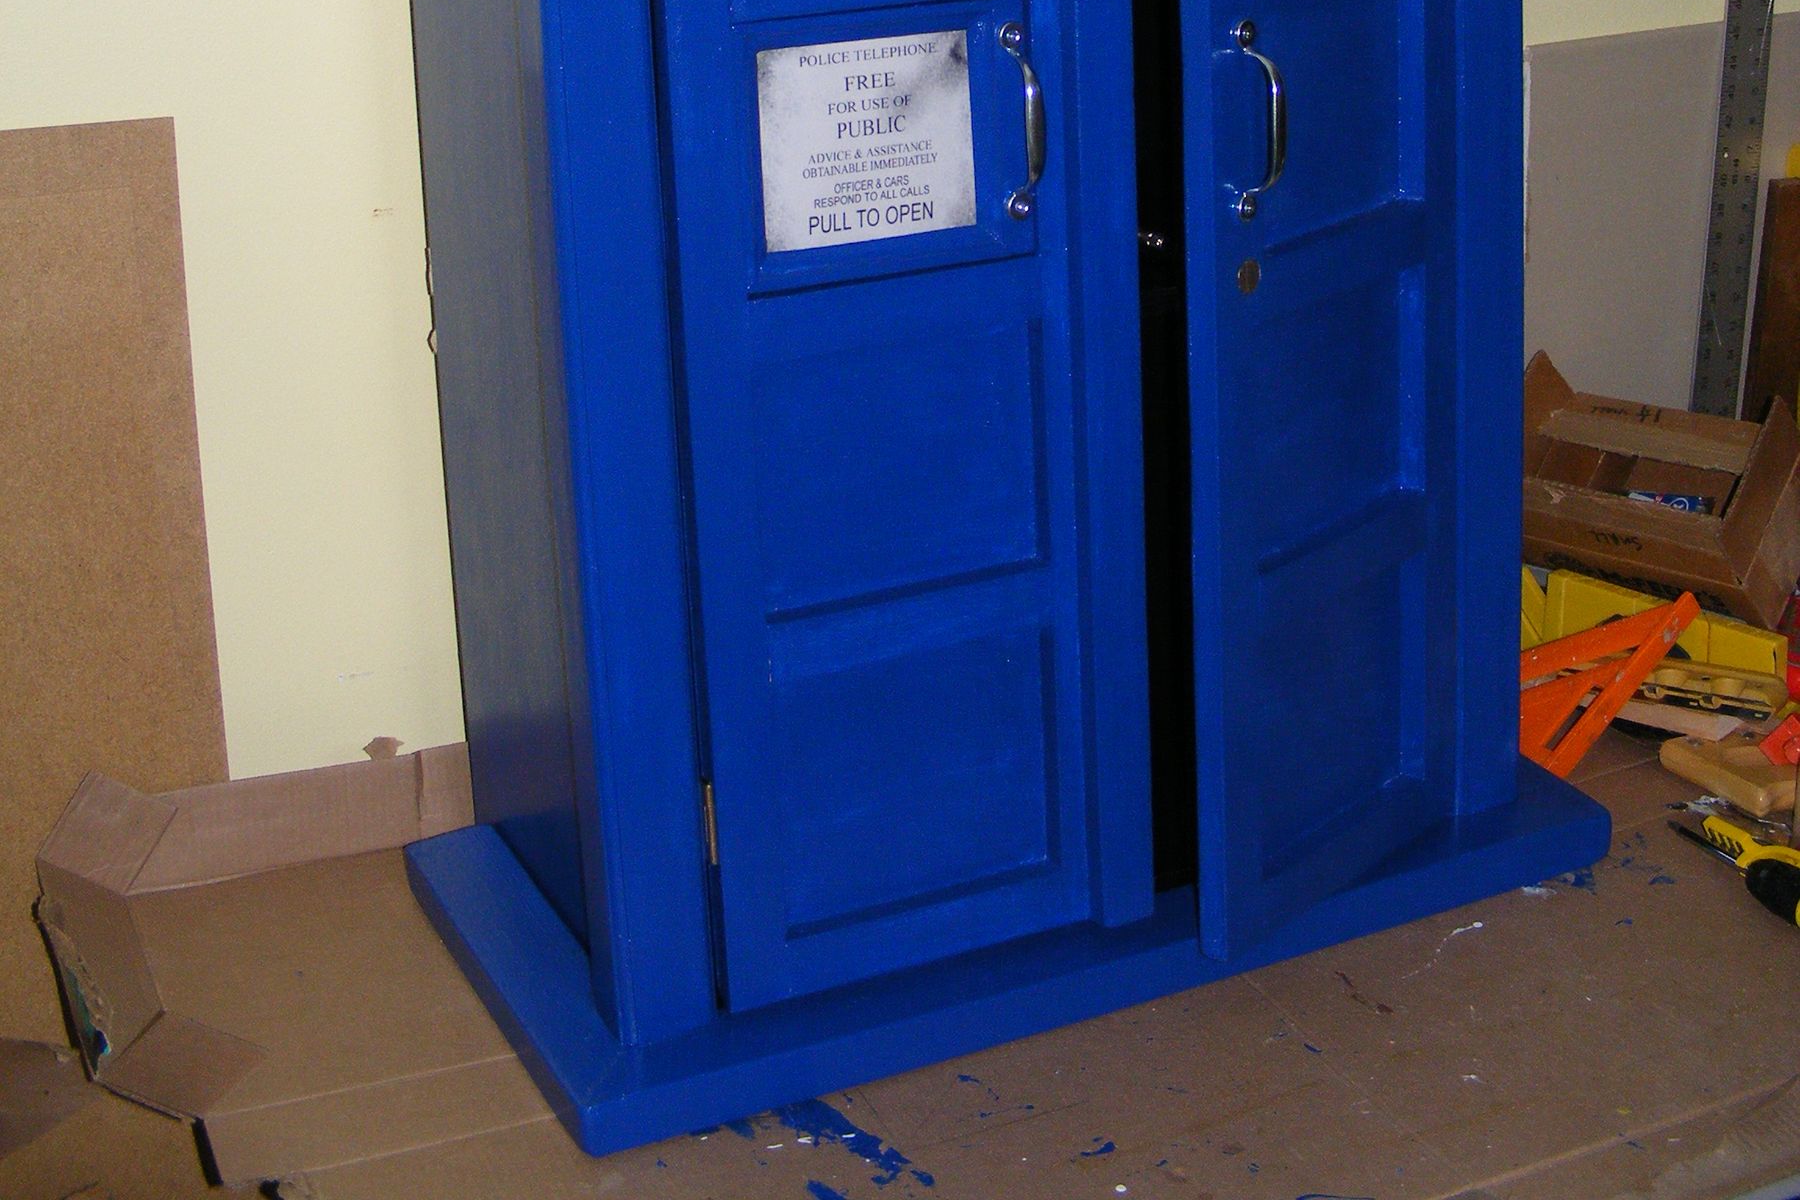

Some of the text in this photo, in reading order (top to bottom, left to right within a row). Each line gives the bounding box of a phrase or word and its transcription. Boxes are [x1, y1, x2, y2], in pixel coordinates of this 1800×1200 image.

[799, 42, 938, 67] POLICE TELEPHONE
[844, 71, 896, 91] FREE
[828, 94, 912, 115] FOR USE OF
[837, 115, 907, 139] PUBLIC
[808, 139, 933, 164] ADVICE & ASSISTANCE
[802, 152, 938, 179] OBTAINABLE IMMEDIATELY
[814, 184, 930, 209] RESPOND TO ALL CALLS
[834, 174, 910, 194] OFFICER & CARS
[808, 200, 934, 235] PULL TO OPEN
